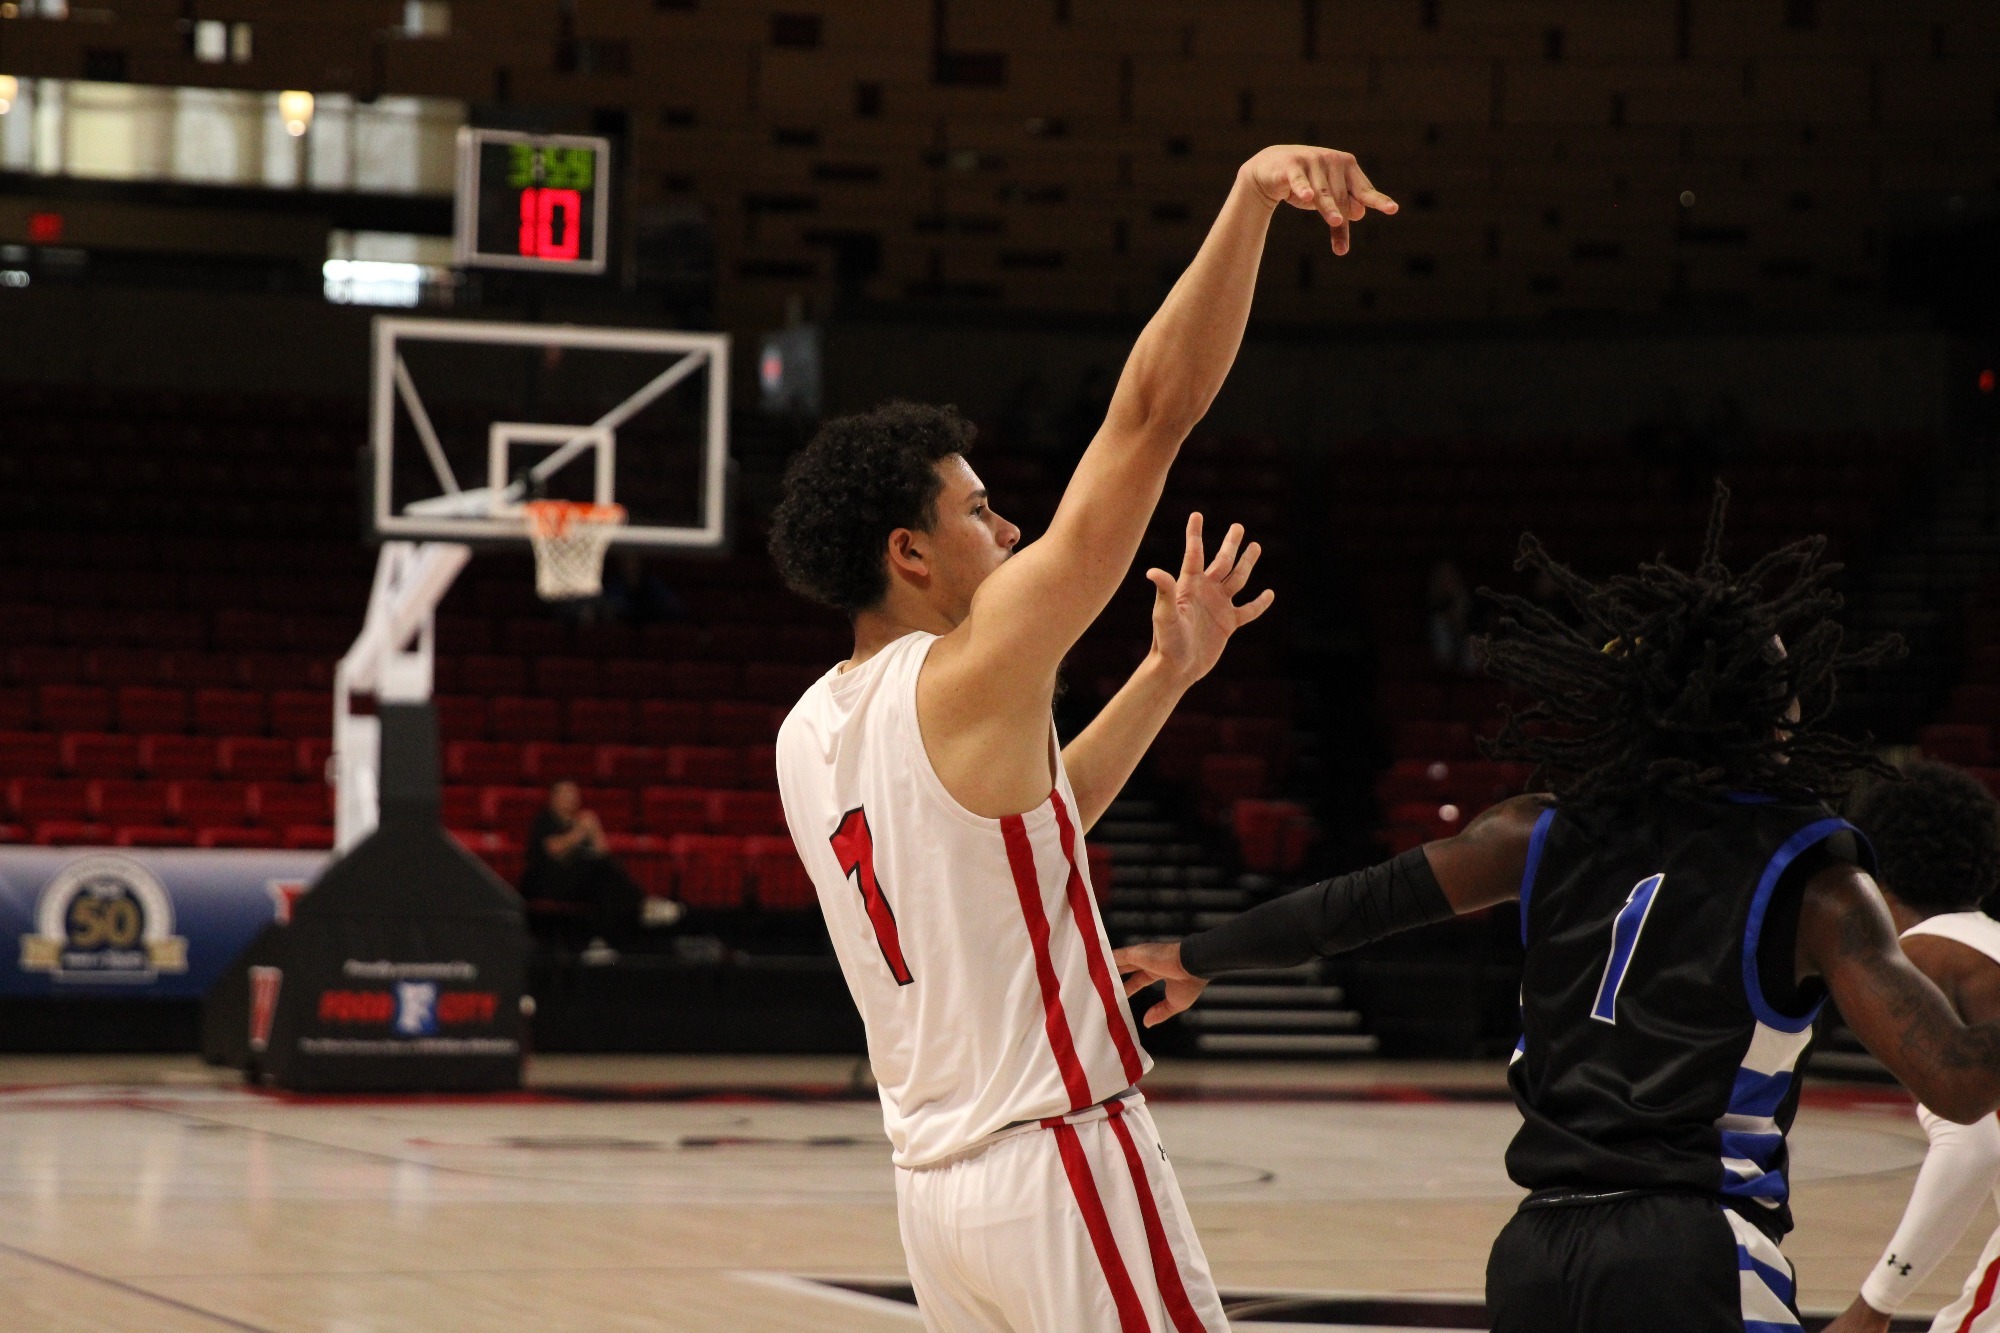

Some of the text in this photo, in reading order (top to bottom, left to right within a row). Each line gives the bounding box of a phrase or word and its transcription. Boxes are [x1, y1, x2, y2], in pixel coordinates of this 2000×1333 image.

[519, 187, 581, 261] 10
[67, 896, 142, 948] 50
[1590, 872, 1665, 1025] 1
